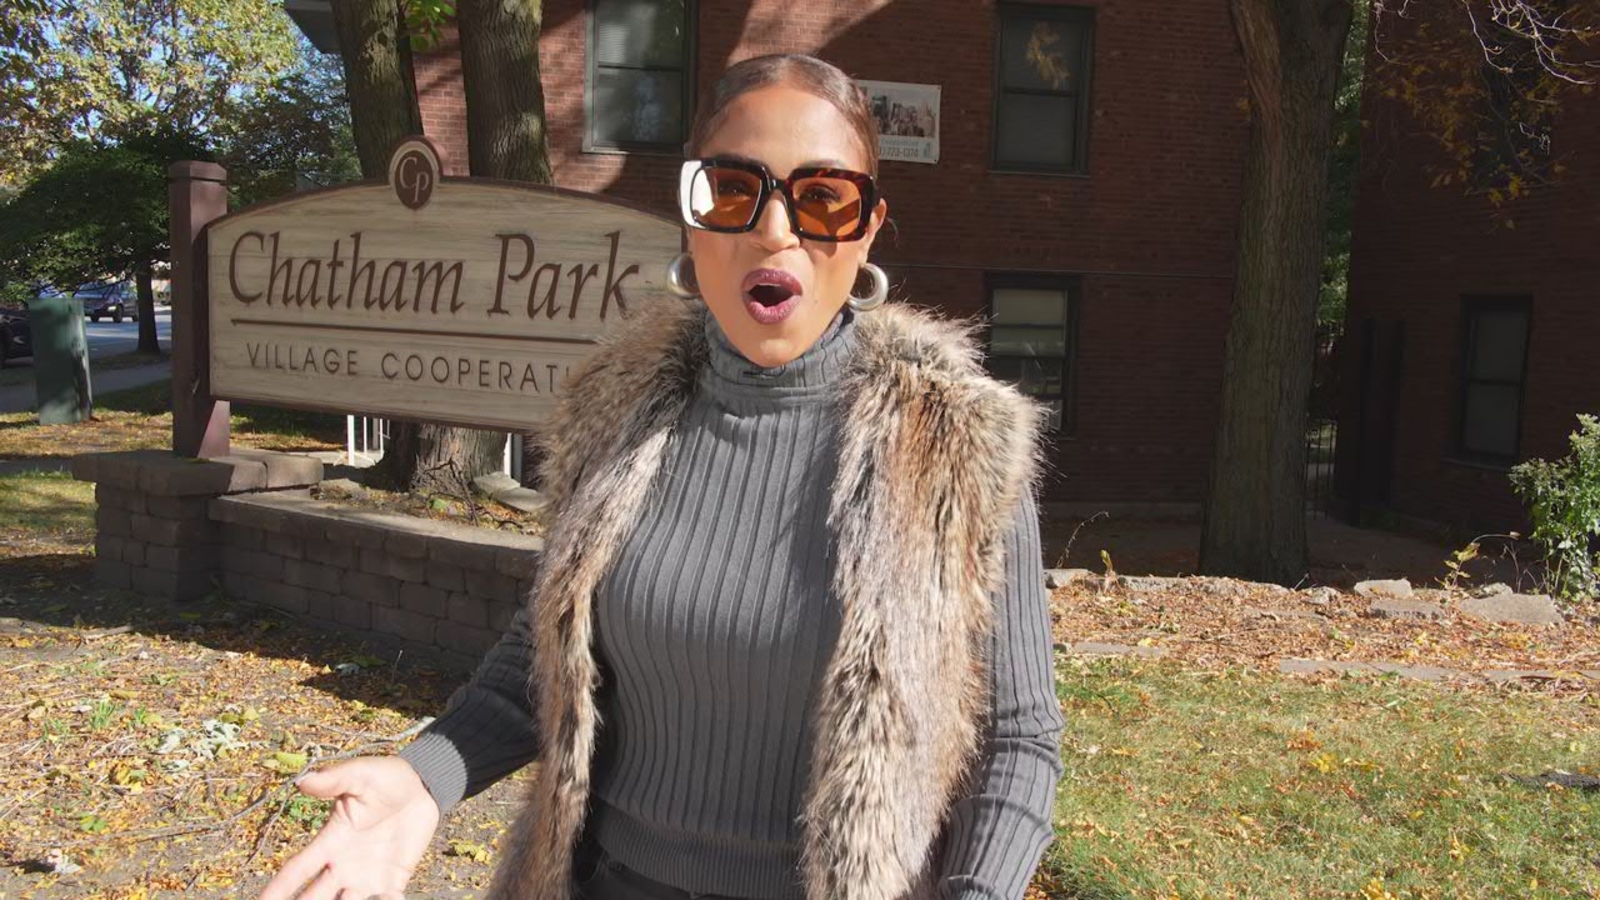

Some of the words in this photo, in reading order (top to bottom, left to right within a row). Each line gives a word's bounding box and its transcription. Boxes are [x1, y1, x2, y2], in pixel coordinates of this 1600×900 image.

[229, 231, 464, 314] Chatham
[487, 231, 640, 321] Park
[246, 343, 358, 376] VILLAGE
